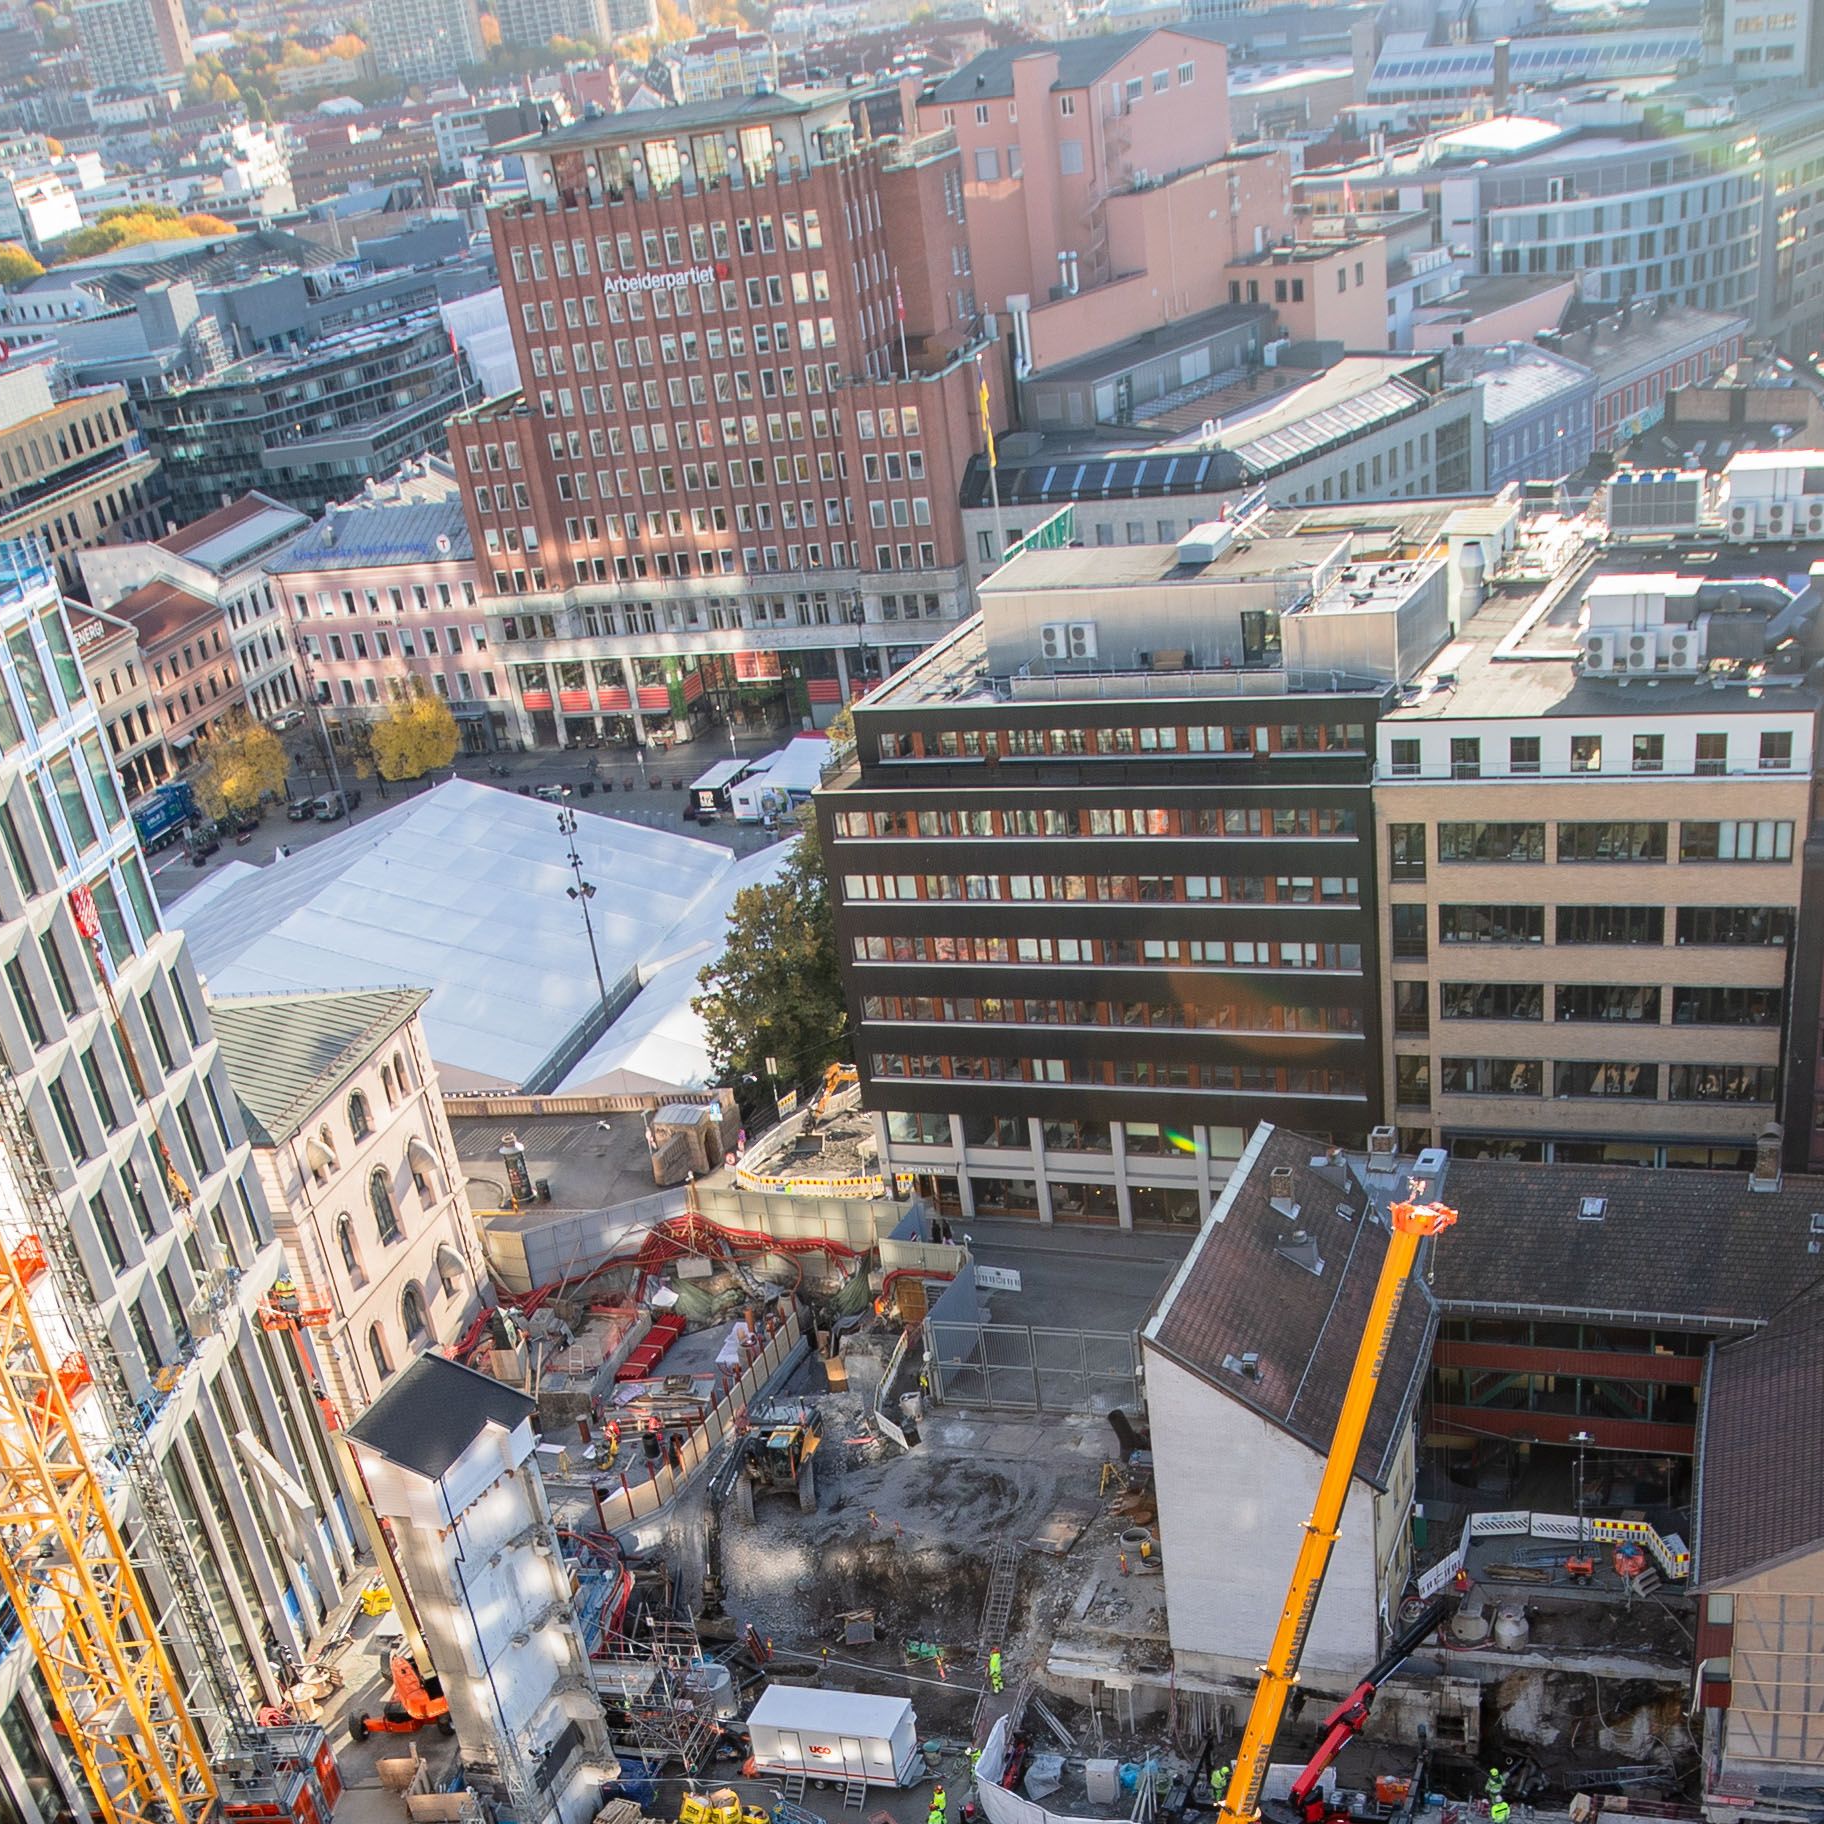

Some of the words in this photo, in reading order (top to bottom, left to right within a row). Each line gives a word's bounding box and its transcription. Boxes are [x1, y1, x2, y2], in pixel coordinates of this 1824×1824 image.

[604, 265, 716, 294] Arbeiderpartiet
[73, 620, 105, 647] ENERGI
[1370, 1276, 1408, 1379] KRANRINGEN
[1283, 1578, 1321, 1679] KRANRINGEN
[809, 1745, 831, 1755] UCO
